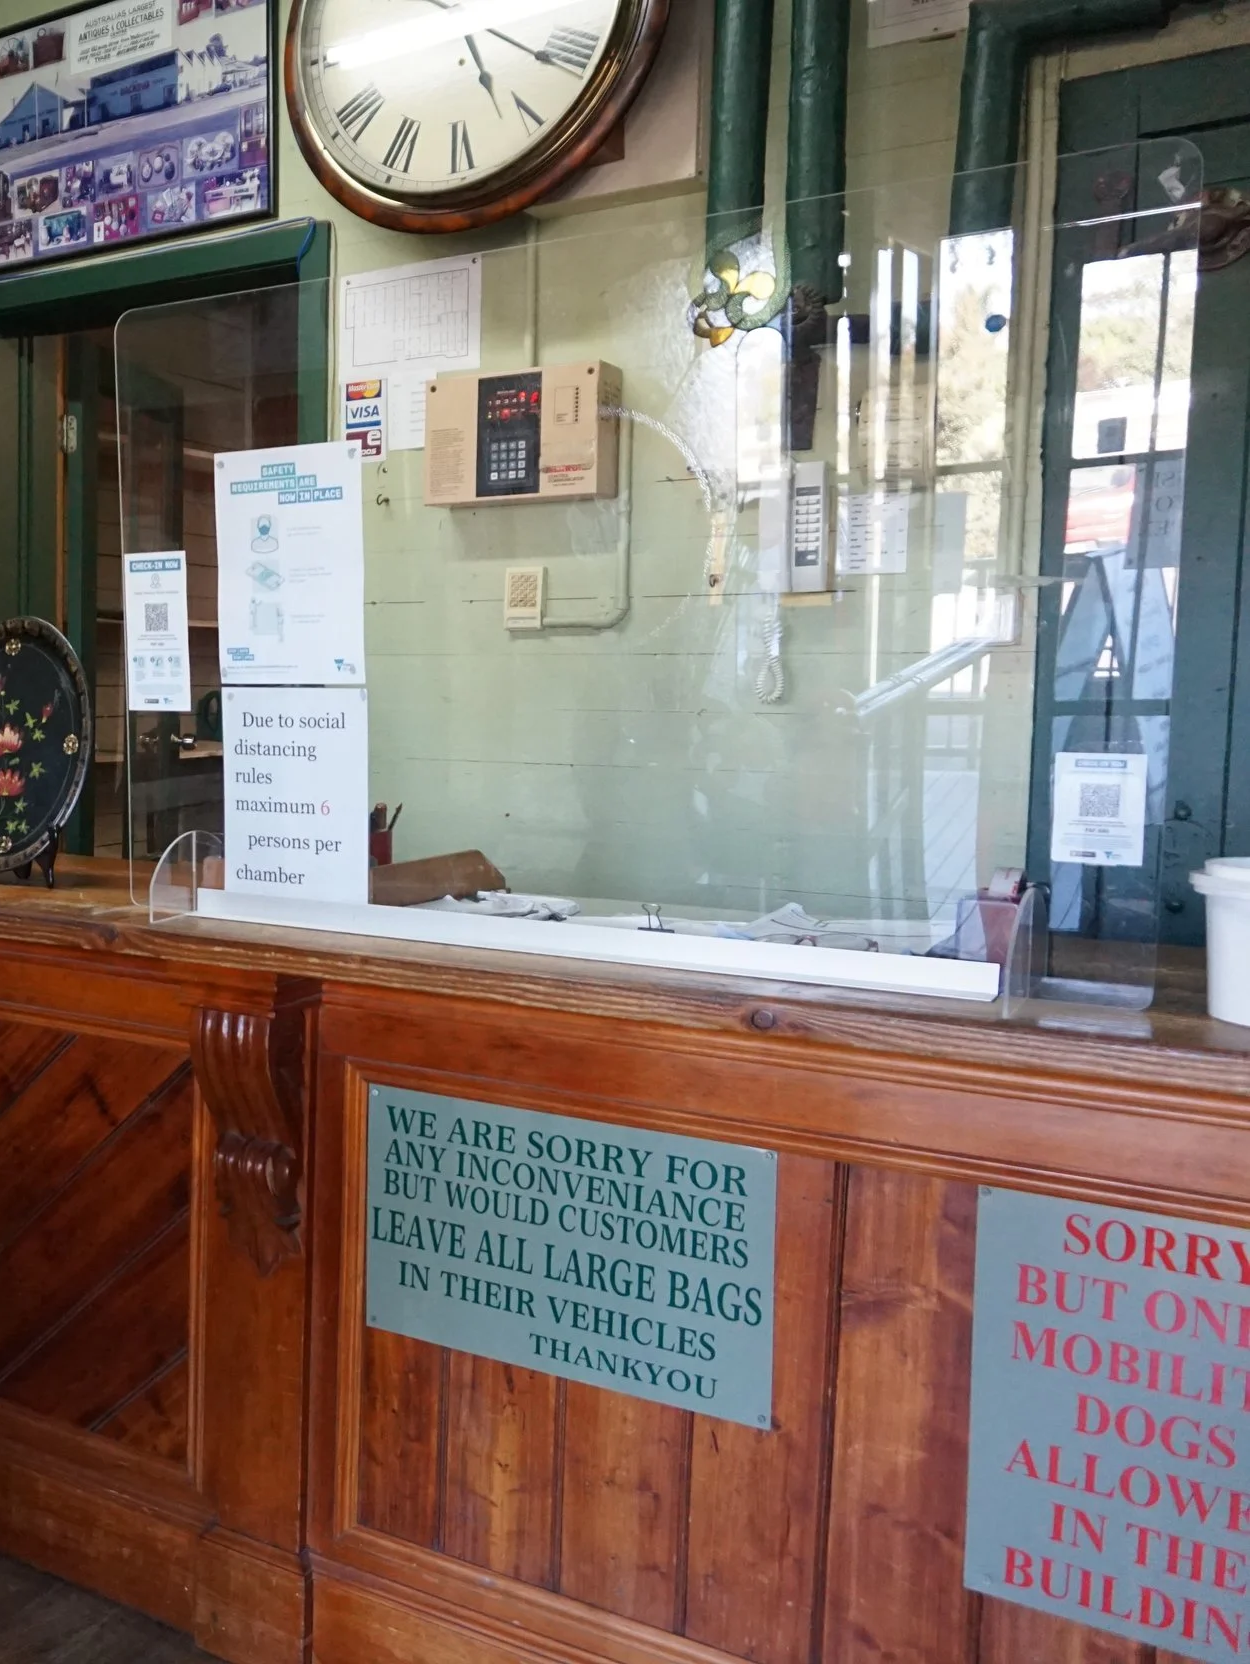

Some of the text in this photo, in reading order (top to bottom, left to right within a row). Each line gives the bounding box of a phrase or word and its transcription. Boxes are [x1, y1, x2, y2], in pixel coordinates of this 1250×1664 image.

[78, 25, 110, 42] ANTIQUES
[116, 8, 165, 30] COLLECTABLES
[350, 404, 380, 419] VISA
[231, 476, 316, 494] REQUIREMENTS ARE
[261, 464, 295, 477] SAFETY
[279, 488, 342, 503] NOW IN PLACE
[131, 559, 179, 571] CHECK-IN NOW
[241, 711, 346, 729] Due to social
[234, 738, 318, 762] distancing
[235, 767, 273, 785] rules
[235, 796, 331, 816] maximum 6
[248, 834, 342, 856] persons per
[235, 863, 306, 885] chamber
[386, 1105, 749, 1198] WE ARE SORRY FOR
[384, 1137, 746, 1234] ANY INCONVENIANCE
[383, 1167, 750, 1269] BUT WOULD CUSTOMERS
[371, 1206, 763, 1327] LEAVE ALL LARGE BAGS
[1063, 1213, 1250, 1286] SORRY
[397, 1259, 717, 1362] IN THEIR VEHICLES
[1015, 1262, 1129, 1323] BUT
[528, 1332, 718, 1401] THANKYOU
[1074, 1392, 1238, 1470] DOGS
[1003, 1438, 1250, 1536] ALLOWE
[1047, 1501, 1248, 1596] IN THE
[1001, 1545, 1250, 1655] BUILDIN
